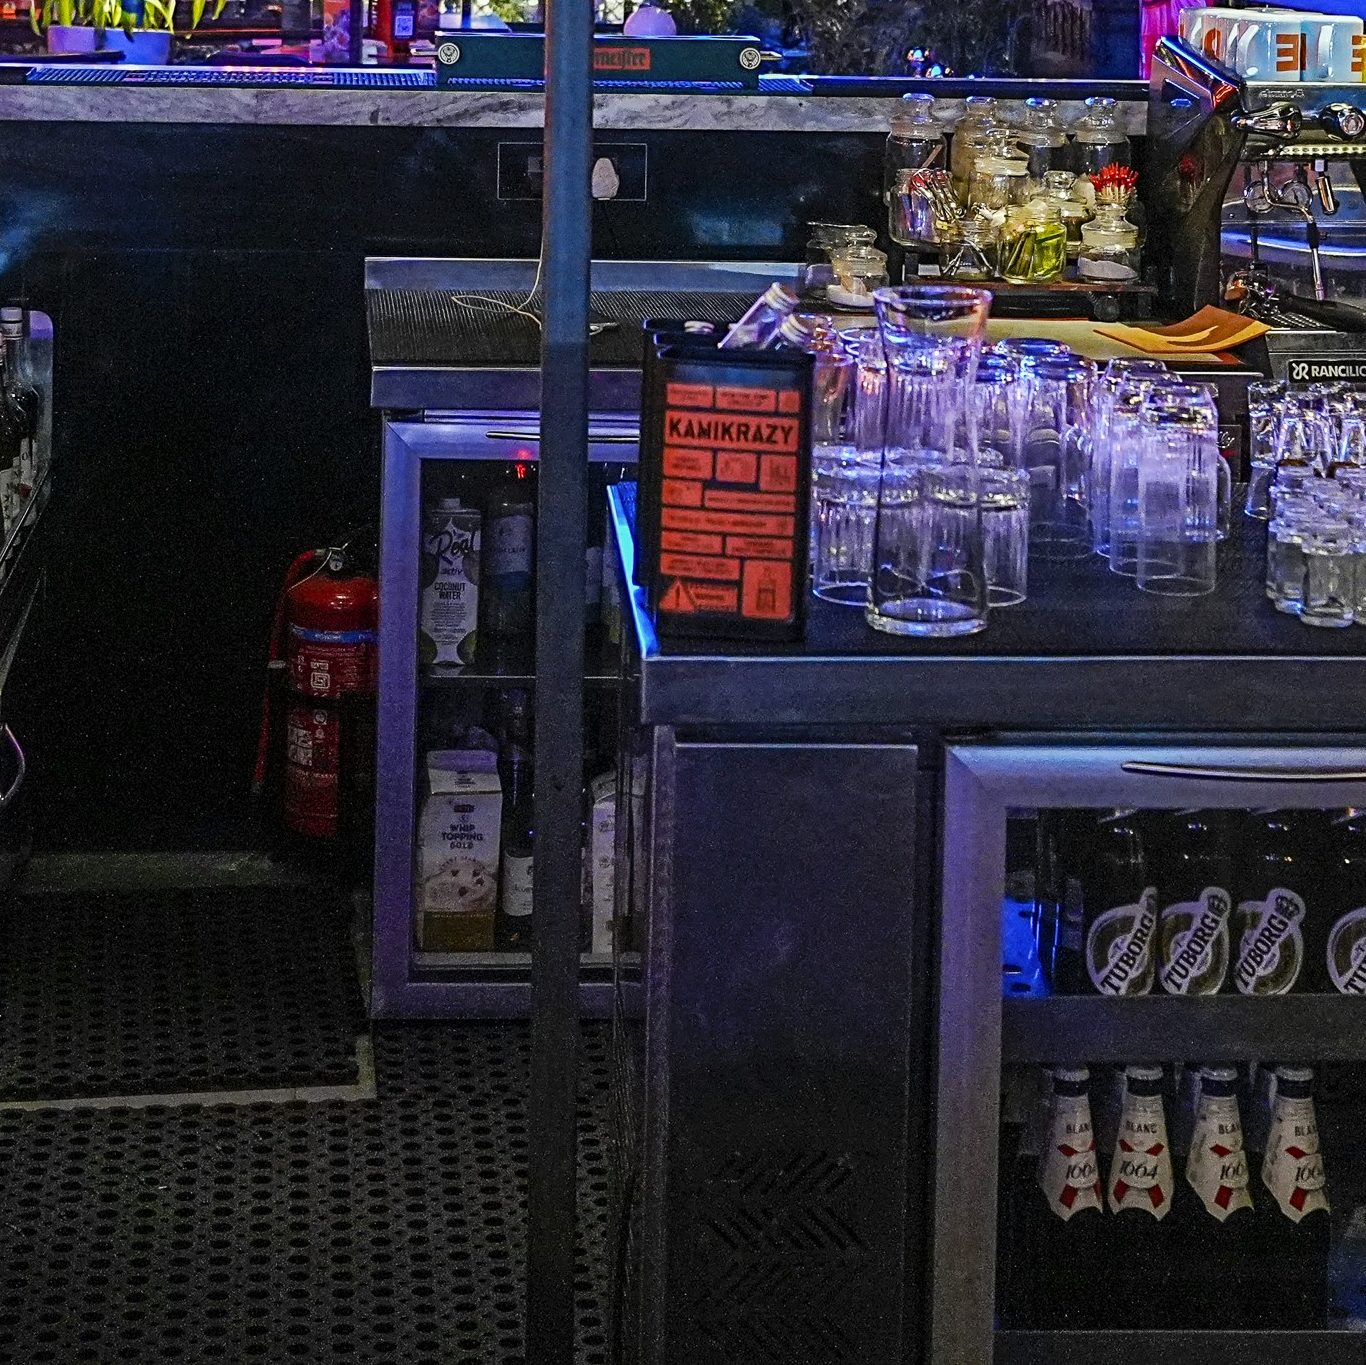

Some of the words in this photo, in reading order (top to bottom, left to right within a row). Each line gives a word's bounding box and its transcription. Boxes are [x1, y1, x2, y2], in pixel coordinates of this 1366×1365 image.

[595, 50, 646, 69] meister
[668, 416, 794, 445] KAMIKRAZY
[434, 581, 466, 591] COCONUT
[441, 832, 484, 841] TOPPING
[449, 823, 476, 832] WHIP
[1100, 914, 1155, 995] TUBORG
[1163, 913, 1220, 992] TUBORG
[1237, 913, 1289, 989] TUBORG
[1125, 1121, 1158, 1134] BLANC
[1120, 1161, 1159, 1180] 1664
